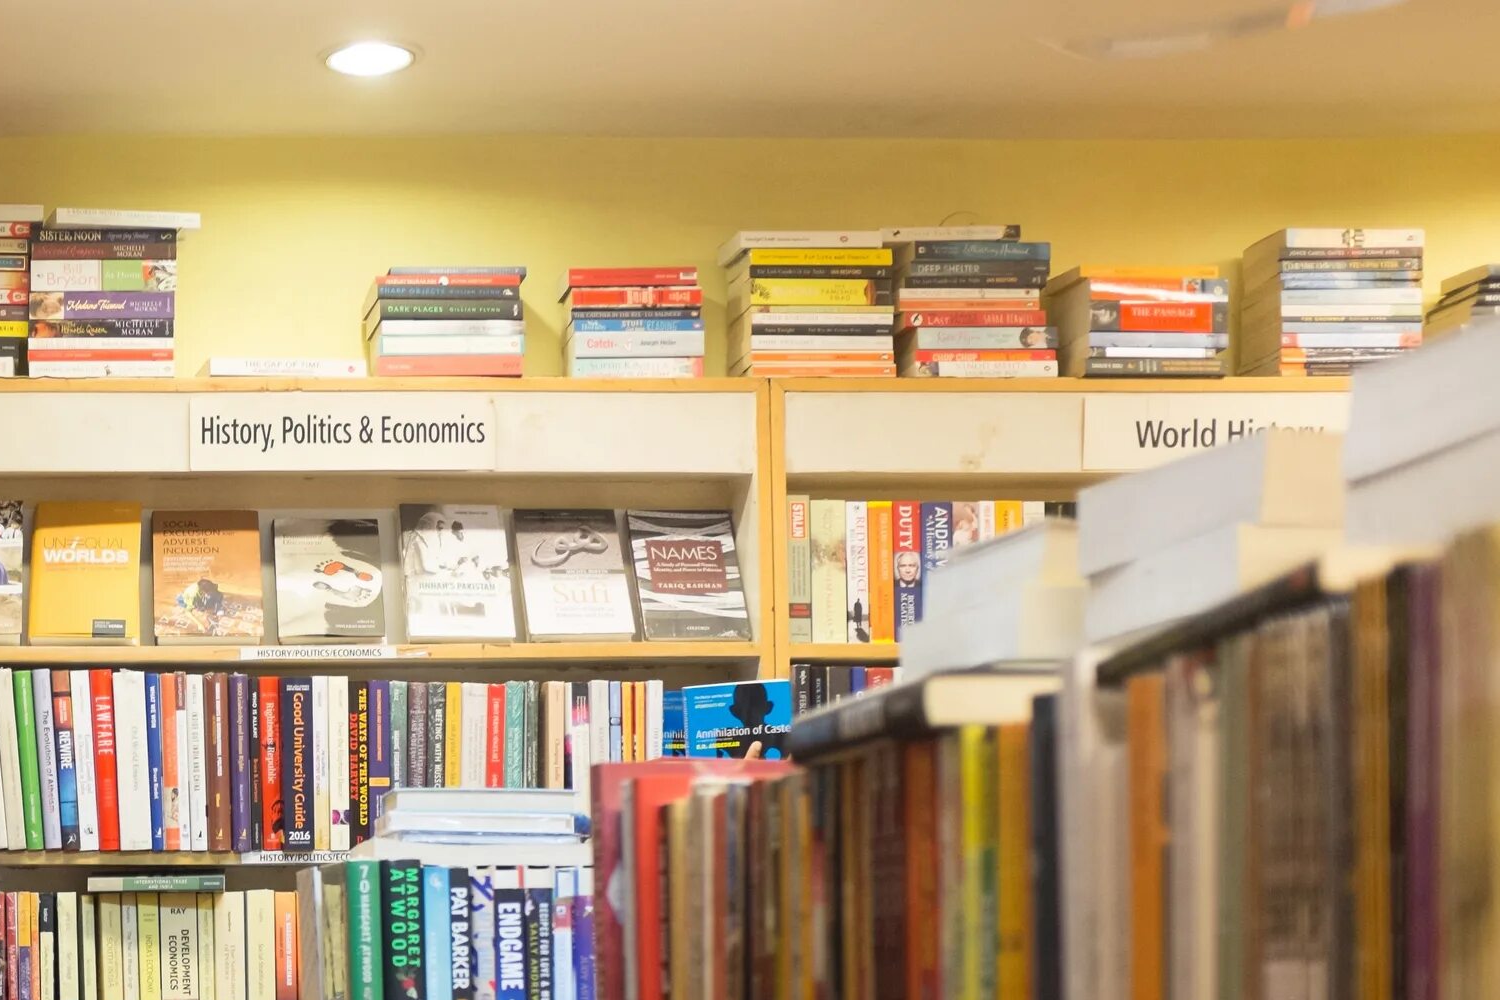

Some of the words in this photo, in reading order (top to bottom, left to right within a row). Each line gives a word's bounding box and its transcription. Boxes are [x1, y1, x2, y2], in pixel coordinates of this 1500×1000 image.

[40, 230, 73, 241] SISTER
[74, 230, 101, 241] NOON
[917, 265, 941, 273] DEEP
[943, 264, 980, 273] SHELTER
[1131, 306, 1151, 317] THE
[1153, 306, 1197, 318] PASSAGE
[121, 327, 154, 335] MORAN
[201, 416, 275, 453] History,
[282, 414, 352, 444] Politics
[358, 415, 375, 444] &
[381, 414, 486, 444] Economics
[1136, 418, 1217, 449] World
[162, 520, 199, 528] SOCIAL
[162, 529, 221, 537] EXCLUSION
[791, 503, 804, 538] STALIN
[856, 516, 866, 542] RED
[899, 505, 913, 550] DUTY
[43, 549, 129, 564] WORLDS
[162, 538, 208, 546] ADVERSE
[163, 547, 220, 555] INCLUSION
[650, 545, 718, 561] NAMES
[925, 527, 935, 560] History
[856, 545, 867, 593] NOTICE
[257, 648, 382, 657] HISTORY/POLITICS/ECONOMICS
[293, 692, 304, 725] Good
[358, 688, 367, 711] THE
[95, 696, 113, 755] LAWFARE
[349, 712, 359, 751] DAVID
[358, 712, 367, 742] WAYS
[696, 726, 750, 740] Annihilation
[752, 725, 762, 735] of
[764, 723, 792, 735] Caste
[58, 730, 73, 769] REWIRE
[292, 727, 305, 791] University
[359, 743, 367, 761] OF
[350, 754, 359, 801] HARVEY
[359, 761, 367, 784] THE
[294, 793, 305, 829] Guide
[359, 785, 368, 826] WORLD
[289, 830, 311, 841] 2016
[170, 907, 186, 915] RAY
[451, 887, 468, 916] PAT
[390, 868, 408, 968] ATWOOD
[405, 868, 420, 968] MARGARET
[498, 902, 524, 990] ENDGAME
[529, 922, 539, 954] SALLY
[168, 935, 179, 991] ECONOMICS
[180, 929, 191, 996] DEVELOPMENT
[451, 922, 469, 989] BARKER
